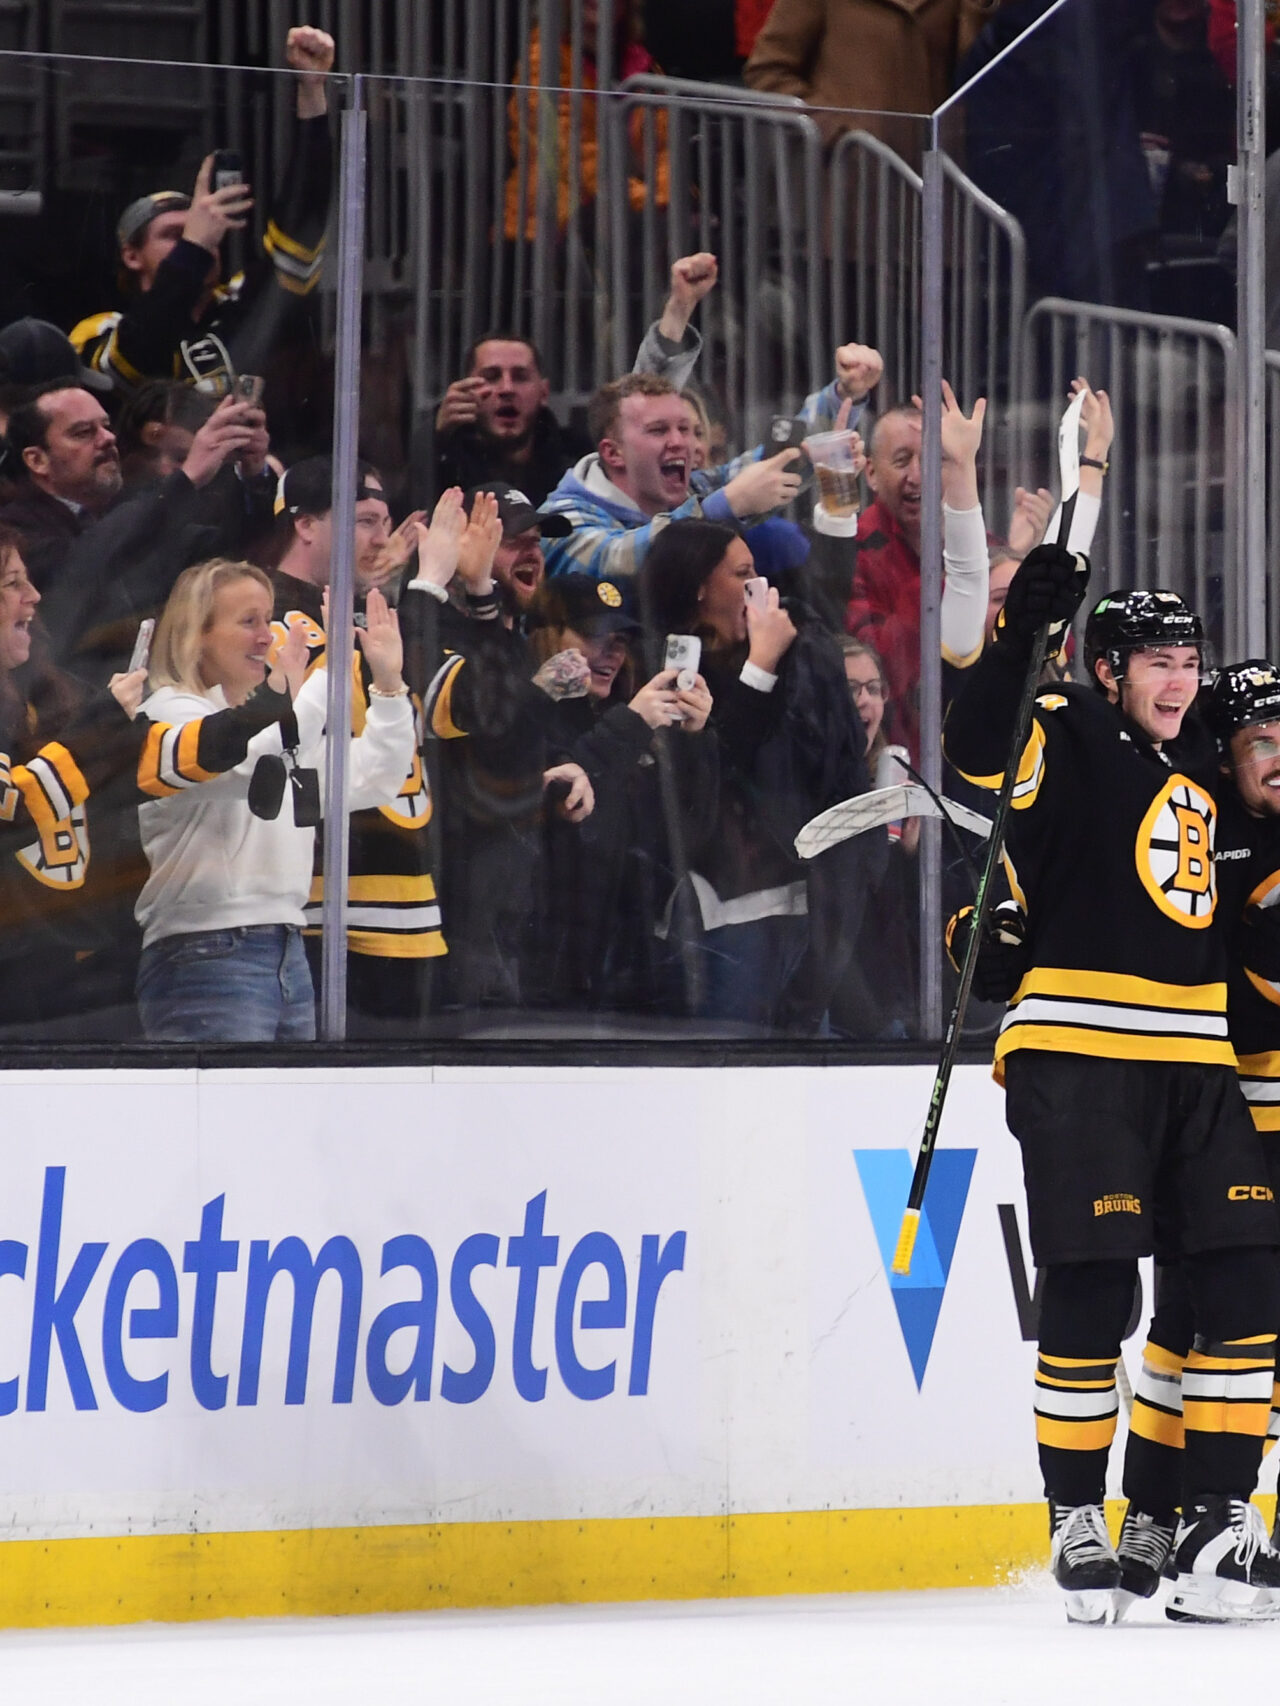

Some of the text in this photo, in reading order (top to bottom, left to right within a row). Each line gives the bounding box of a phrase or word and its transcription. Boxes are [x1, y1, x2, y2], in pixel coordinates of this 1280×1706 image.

[1162, 615, 1194, 625] CCM
[1093, 1198, 1142, 1217] BRUINS
[0, 1165, 687, 1417] ketmaster
